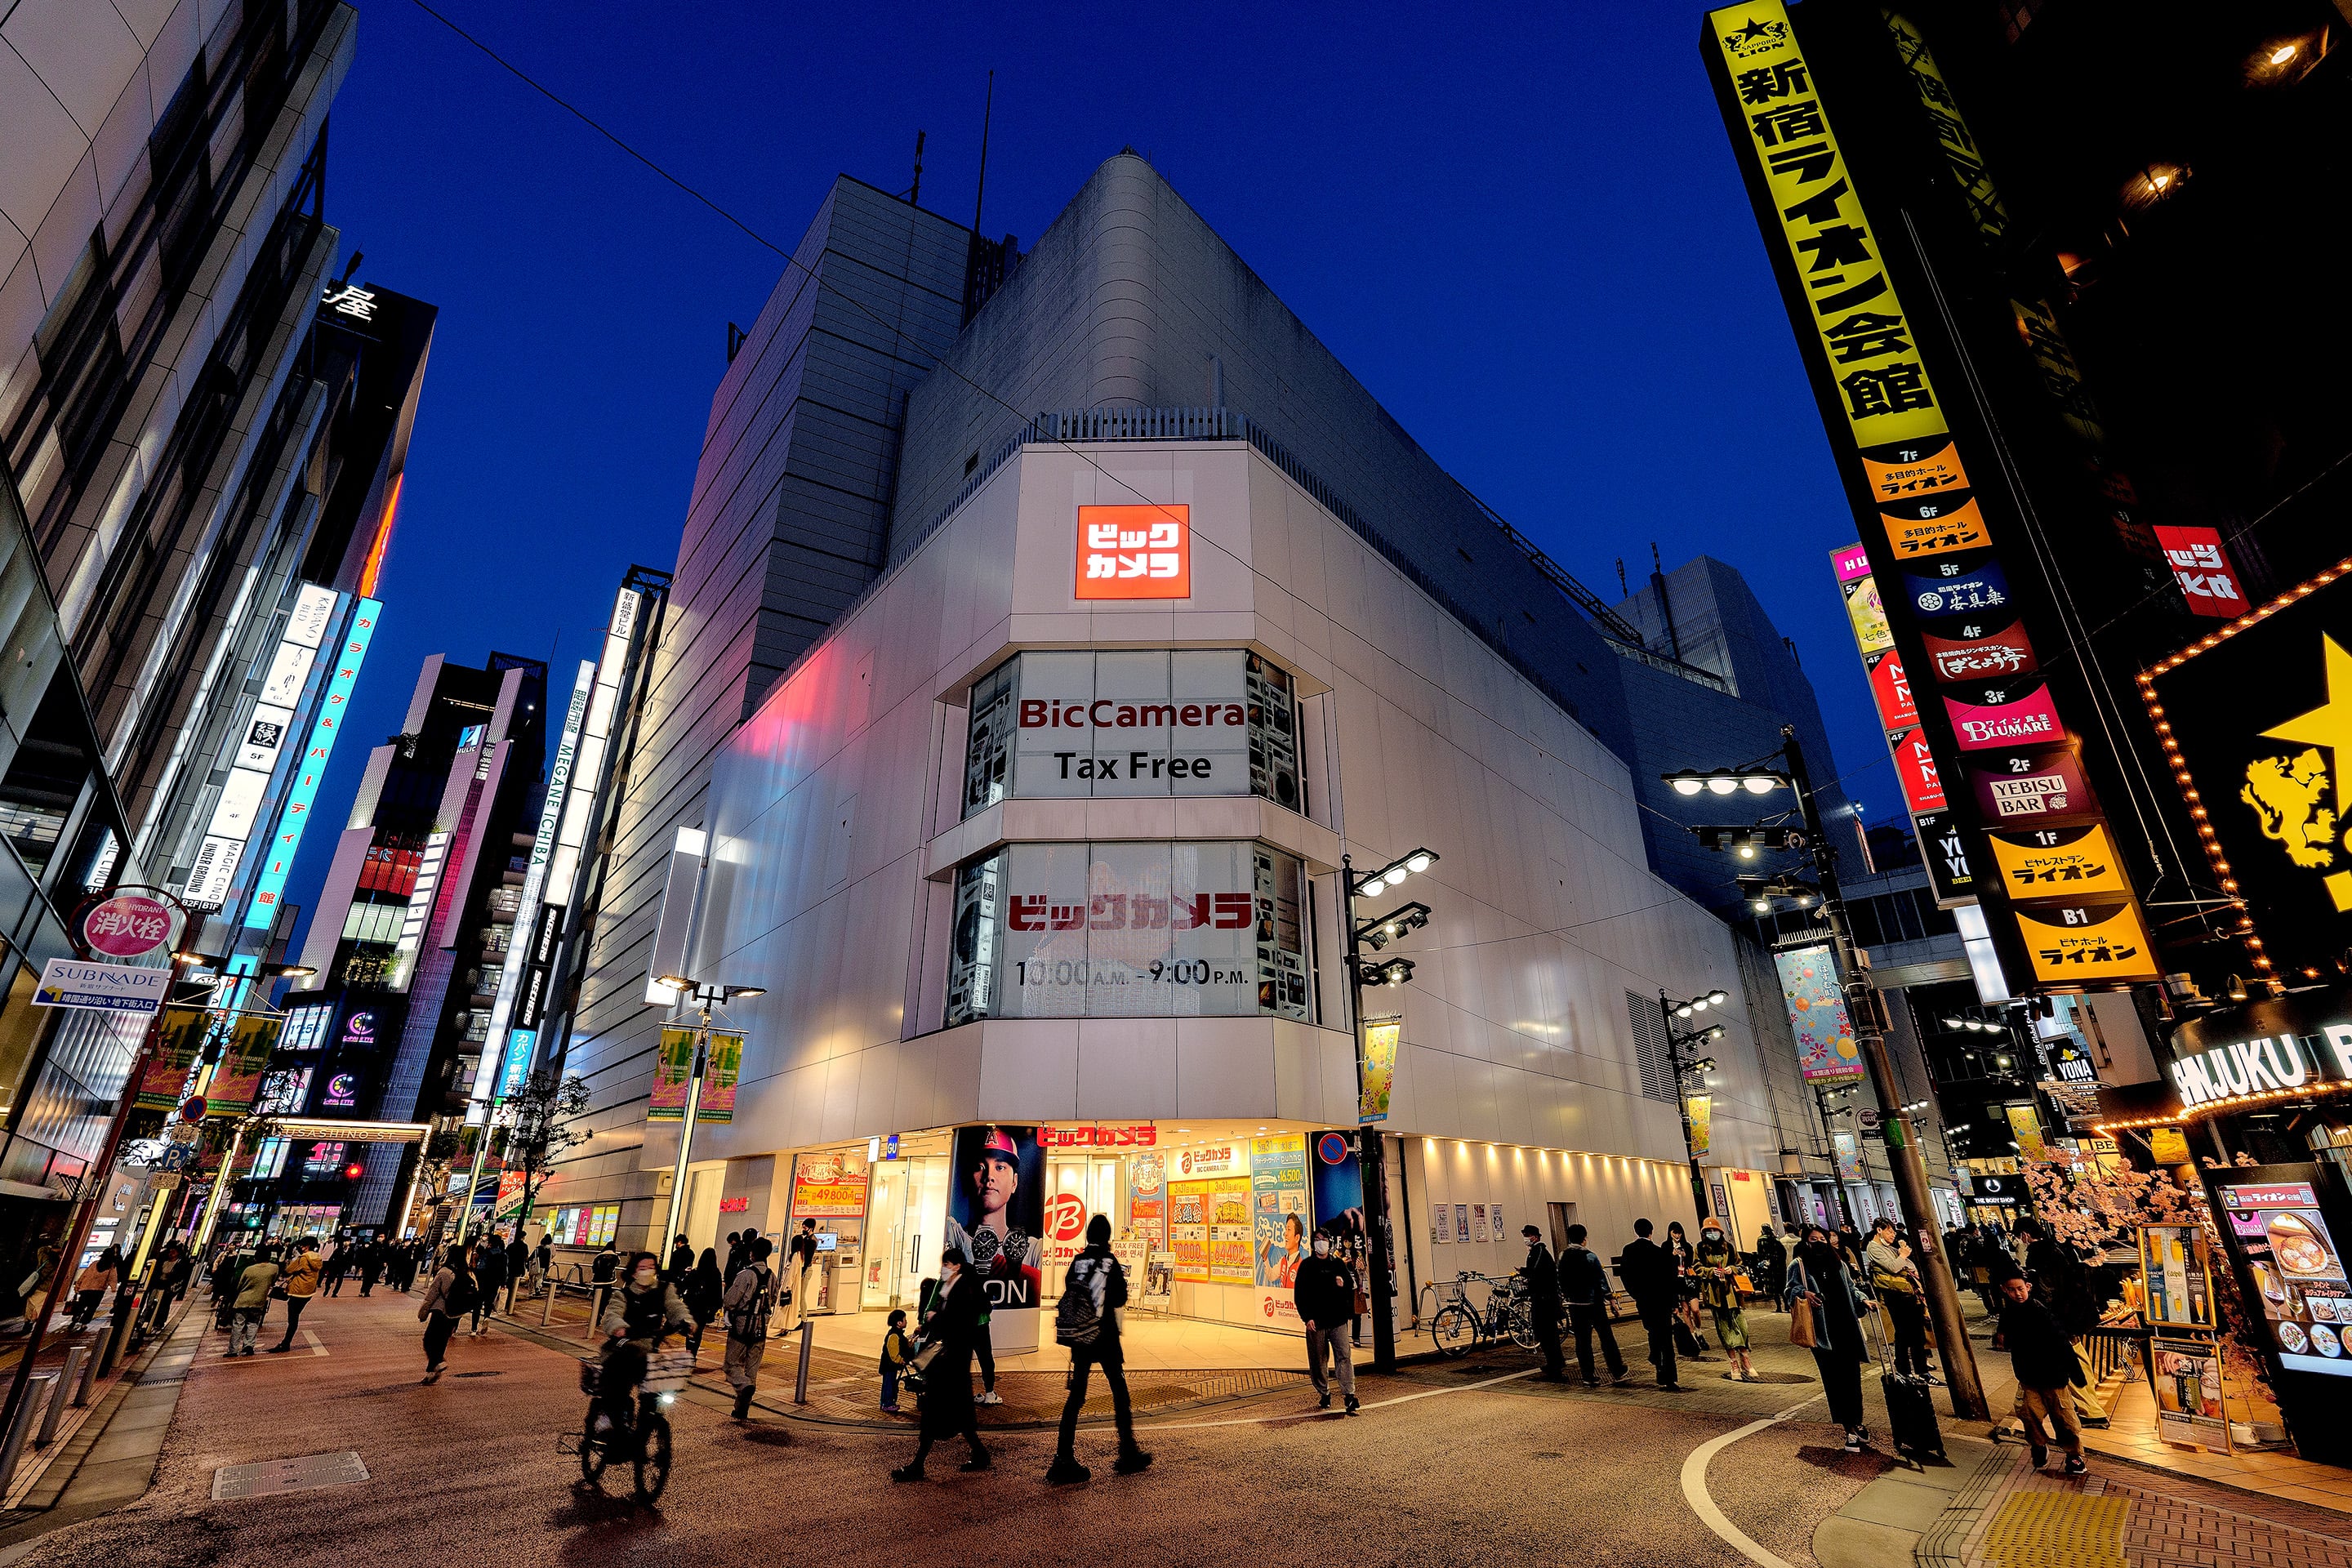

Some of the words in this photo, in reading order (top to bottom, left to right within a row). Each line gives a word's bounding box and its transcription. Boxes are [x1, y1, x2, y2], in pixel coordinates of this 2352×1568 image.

[1738, 41, 1785, 59] LION
[1741, 38, 1776, 51] SAPPORO
[1736, 57, 1935, 421] 新宿ライオン会館
[322, 283, 378, 323] 屋
[1899, 450, 1918, 462] 7F
[1885, 464, 1947, 481] 多目的ホール
[1880, 474, 1958, 495] ライオン
[1919, 506, 1938, 519] 6F
[1087, 523, 1179, 550] ビック
[1904, 520, 1967, 538] 多目的ホール
[1900, 531, 1980, 552] ライオン
[1086, 553, 1180, 579] カメラ
[1940, 564, 1959, 577] 5F
[1845, 585, 1857, 595] 5F
[305, 596, 331, 639] KAWANO
[615, 591, 635, 635] 新盛堂ビル
[1962, 625, 1982, 638] 4F
[1867, 655, 1881, 665] 4F
[1900, 700, 1915, 708] PA
[1984, 690, 2006, 704] 3F
[1018, 699, 1246, 729] BicCamera
[1894, 710, 1918, 720] SHABU-S
[1891, 732, 1904, 742] 4F
[1962, 720, 2053, 742] BLUMARE
[250, 752, 265, 760] 5F
[456, 746, 477, 755] HULIC
[258, 617, 373, 906] カラオケ&パーティー館
[1054, 752, 1118, 781] Tax
[1130, 751, 1213, 780] Free
[2009, 758, 2031, 773] 2F
[546, 742, 574, 808] MEGANE
[1926, 782, 1942, 790] PA
[1995, 777, 2063, 796] YEBISU
[1919, 792, 1945, 802] SHABU-S
[2000, 797, 2042, 813] BAR
[1919, 817, 1936, 826] B1F
[532, 813, 557, 866] ICHIBA
[2034, 831, 2058, 846] 1F
[198, 843, 219, 866] UNDER
[218, 841, 239, 874] MAGIC
[2024, 854, 2085, 867] ビヤレストラン
[188, 866, 210, 893] GROUND
[2011, 863, 2106, 884] ライオン
[207, 877, 226, 901] CINQ
[107, 901, 127, 910] FIRE
[128, 903, 165, 914] HYDRANT
[180, 898, 201, 907] B2F
[201, 902, 220, 911] B1F
[1008, 891, 1254, 932] ビックカメラ
[2061, 908, 2088, 925] B1
[91, 911, 166, 941] 消火栓
[538, 908, 558, 963] SKECHERS
[2038, 944, 2138, 965] ライオン
[51, 966, 162, 987] SUBNADE
[61, 993, 111, 1006] 靖国通り沿い
[111, 996, 154, 1010] 地下街入口
[523, 969, 543, 1027] SKECHERS
[2029, 1027, 2040, 1045] Global
[512, 1033, 530, 1062] カバン
[2034, 1044, 2047, 1065] GINZA
[2045, 1043, 2055, 1051] B1F
[2056, 1058, 2094, 1080] YONA
[1036, 1126, 1156, 1147] ビックカメラ
[2095, 1140, 2117, 1150] BE
[165, 1149, 180, 1167] P
[887, 1143, 898, 1155] GU
[1193, 1147, 1232, 1163] ビックカメラ
